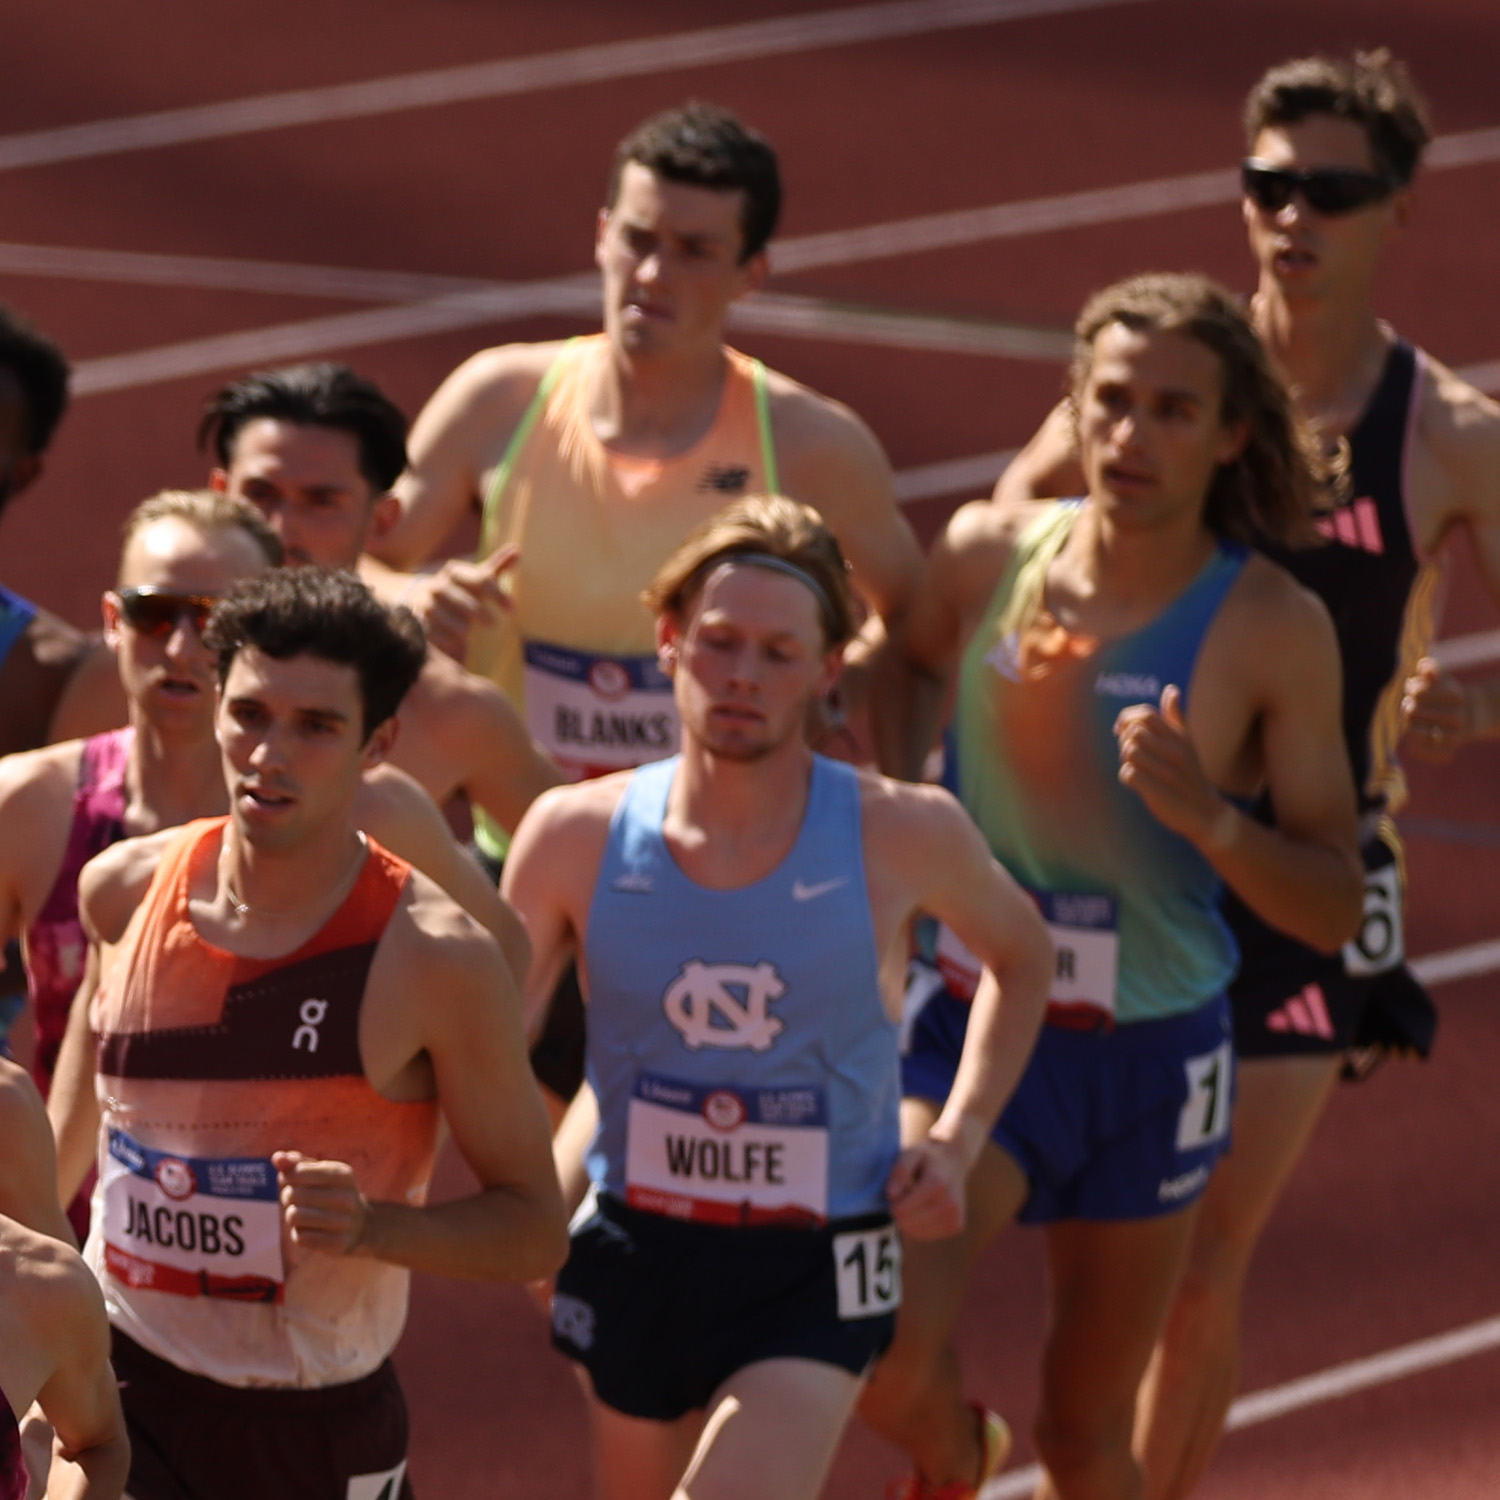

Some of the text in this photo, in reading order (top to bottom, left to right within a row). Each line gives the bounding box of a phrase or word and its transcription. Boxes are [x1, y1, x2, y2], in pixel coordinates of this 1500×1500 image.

[556, 705, 671, 749] BLANKS
[666, 1133, 784, 1184] WOLFE
[125, 1196, 245, 1256] JACOBS
[844, 1237, 893, 1305] 15
